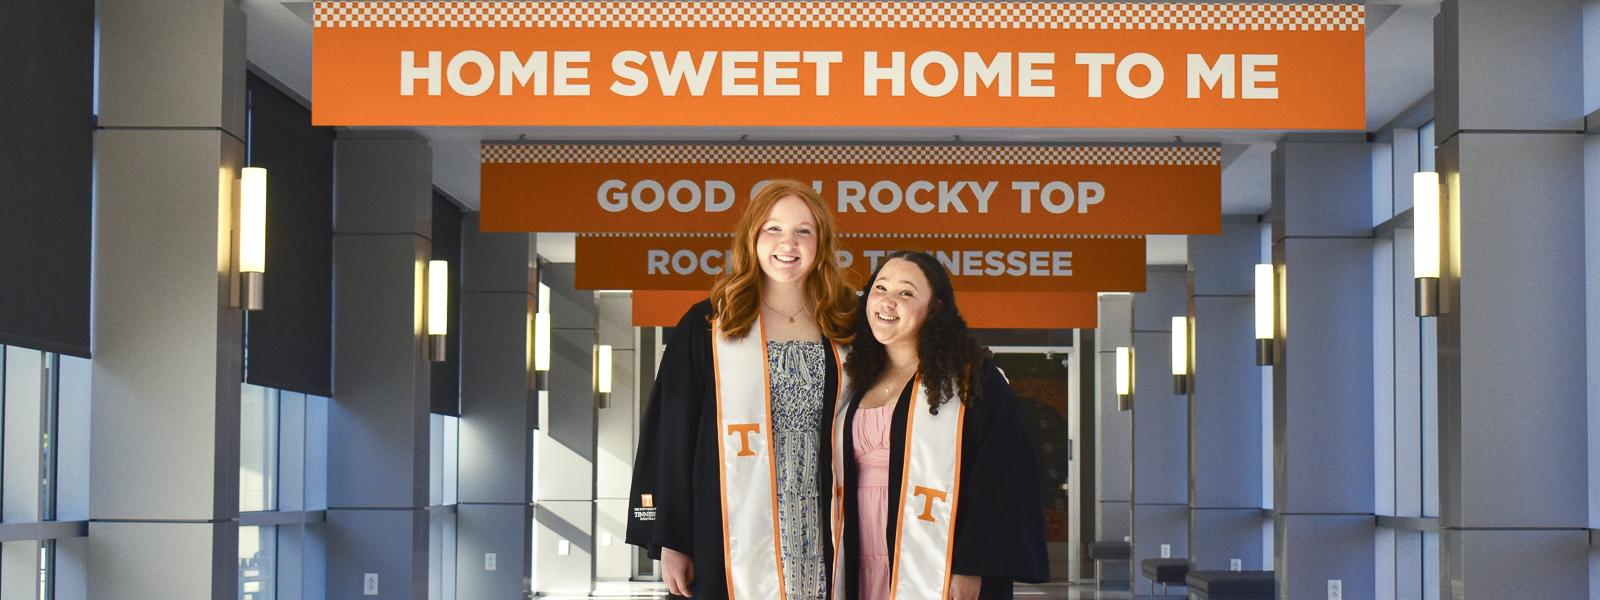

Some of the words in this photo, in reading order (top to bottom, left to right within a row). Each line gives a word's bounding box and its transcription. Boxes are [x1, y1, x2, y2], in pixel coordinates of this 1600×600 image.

[400, 50, 590, 98] HOME
[609, 50, 843, 98] SWEET
[863, 51, 1056, 99] HOME
[1075, 52, 1165, 100] TO
[1186, 53, 1279, 100] ME
[597, 180, 735, 214] GOOD
[837, 180, 999, 214] ROCKY
[1011, 181, 1105, 214] TOP
[863, 250, 1073, 277] TNESSEE
[727, 422, 760, 457] T
[913, 485, 948, 523] T
